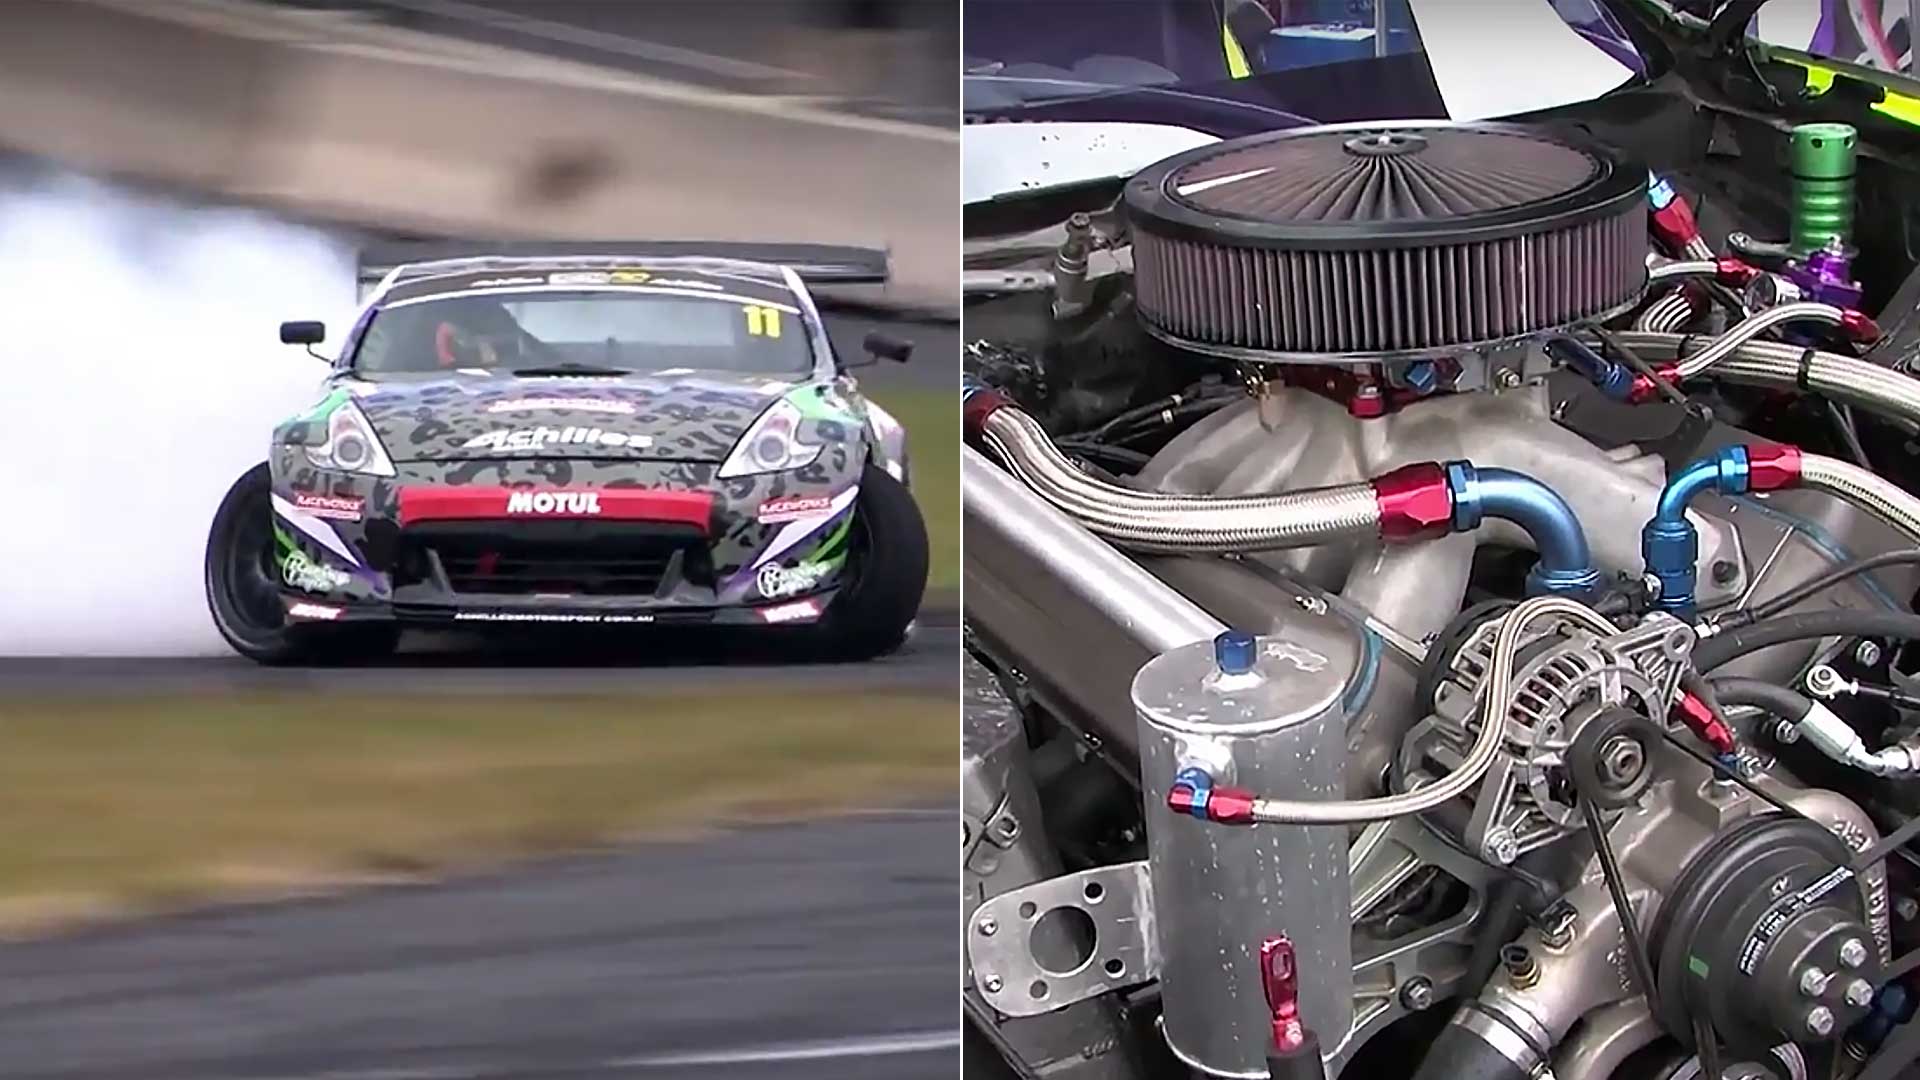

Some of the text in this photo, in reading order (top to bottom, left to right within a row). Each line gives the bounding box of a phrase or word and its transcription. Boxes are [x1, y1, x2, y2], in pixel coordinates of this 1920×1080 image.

[743, 305, 780, 337] 11
[462, 427, 653, 449] Achilles
[507, 492, 601, 513] MOTUL
